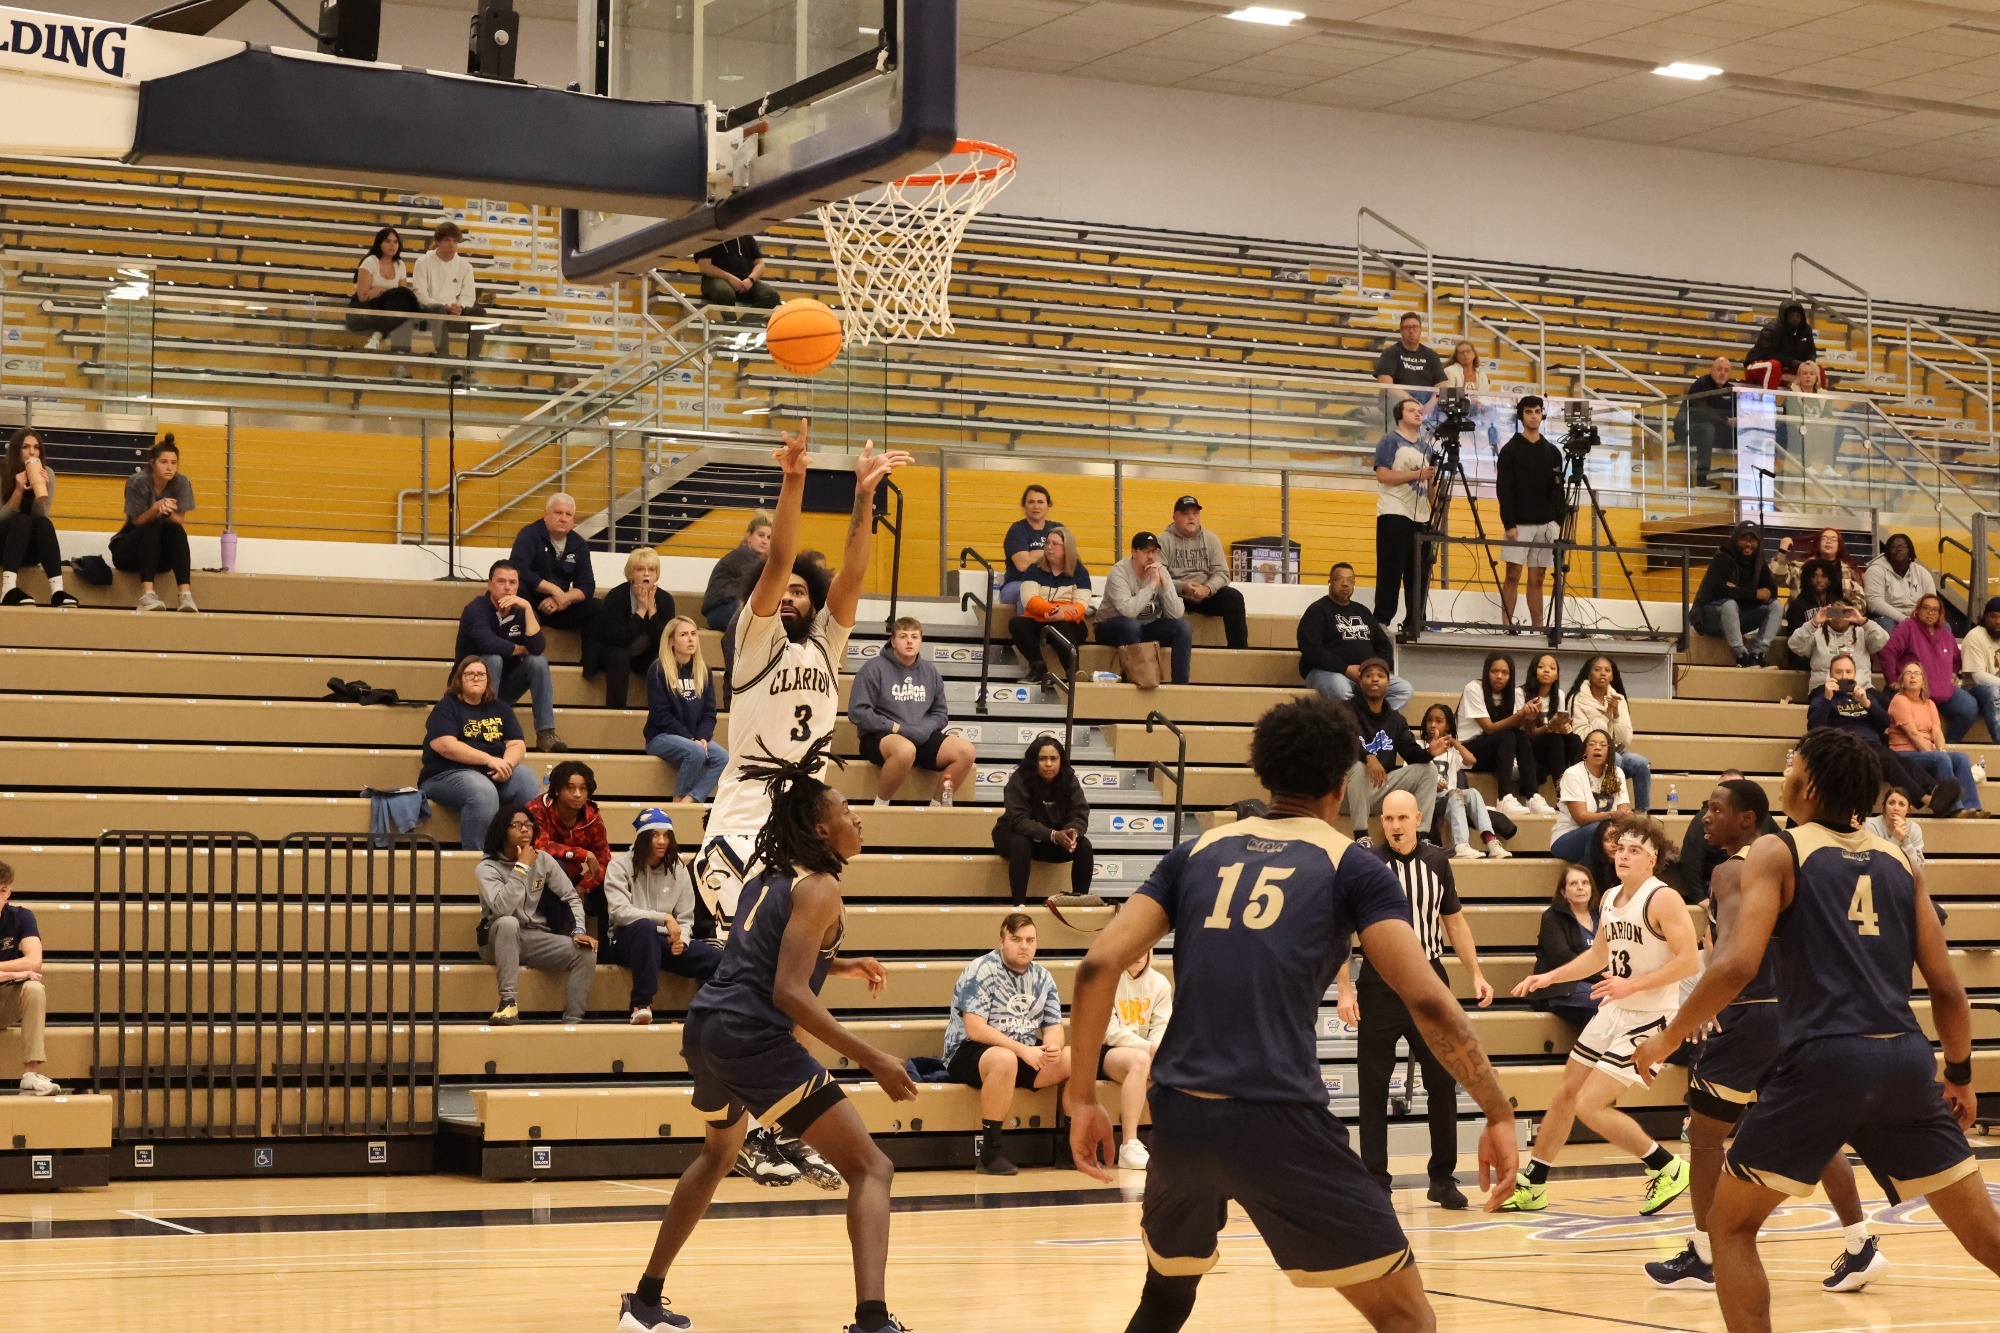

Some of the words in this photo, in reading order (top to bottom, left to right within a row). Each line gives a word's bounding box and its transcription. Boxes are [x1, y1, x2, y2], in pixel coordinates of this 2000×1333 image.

[0, 20, 127, 78] DING
[769, 666, 830, 698] CLARION
[790, 704, 813, 742] 3
[1203, 861, 1297, 930] 15
[1847, 874, 1880, 936] 4
[1611, 949, 1632, 979] 13
